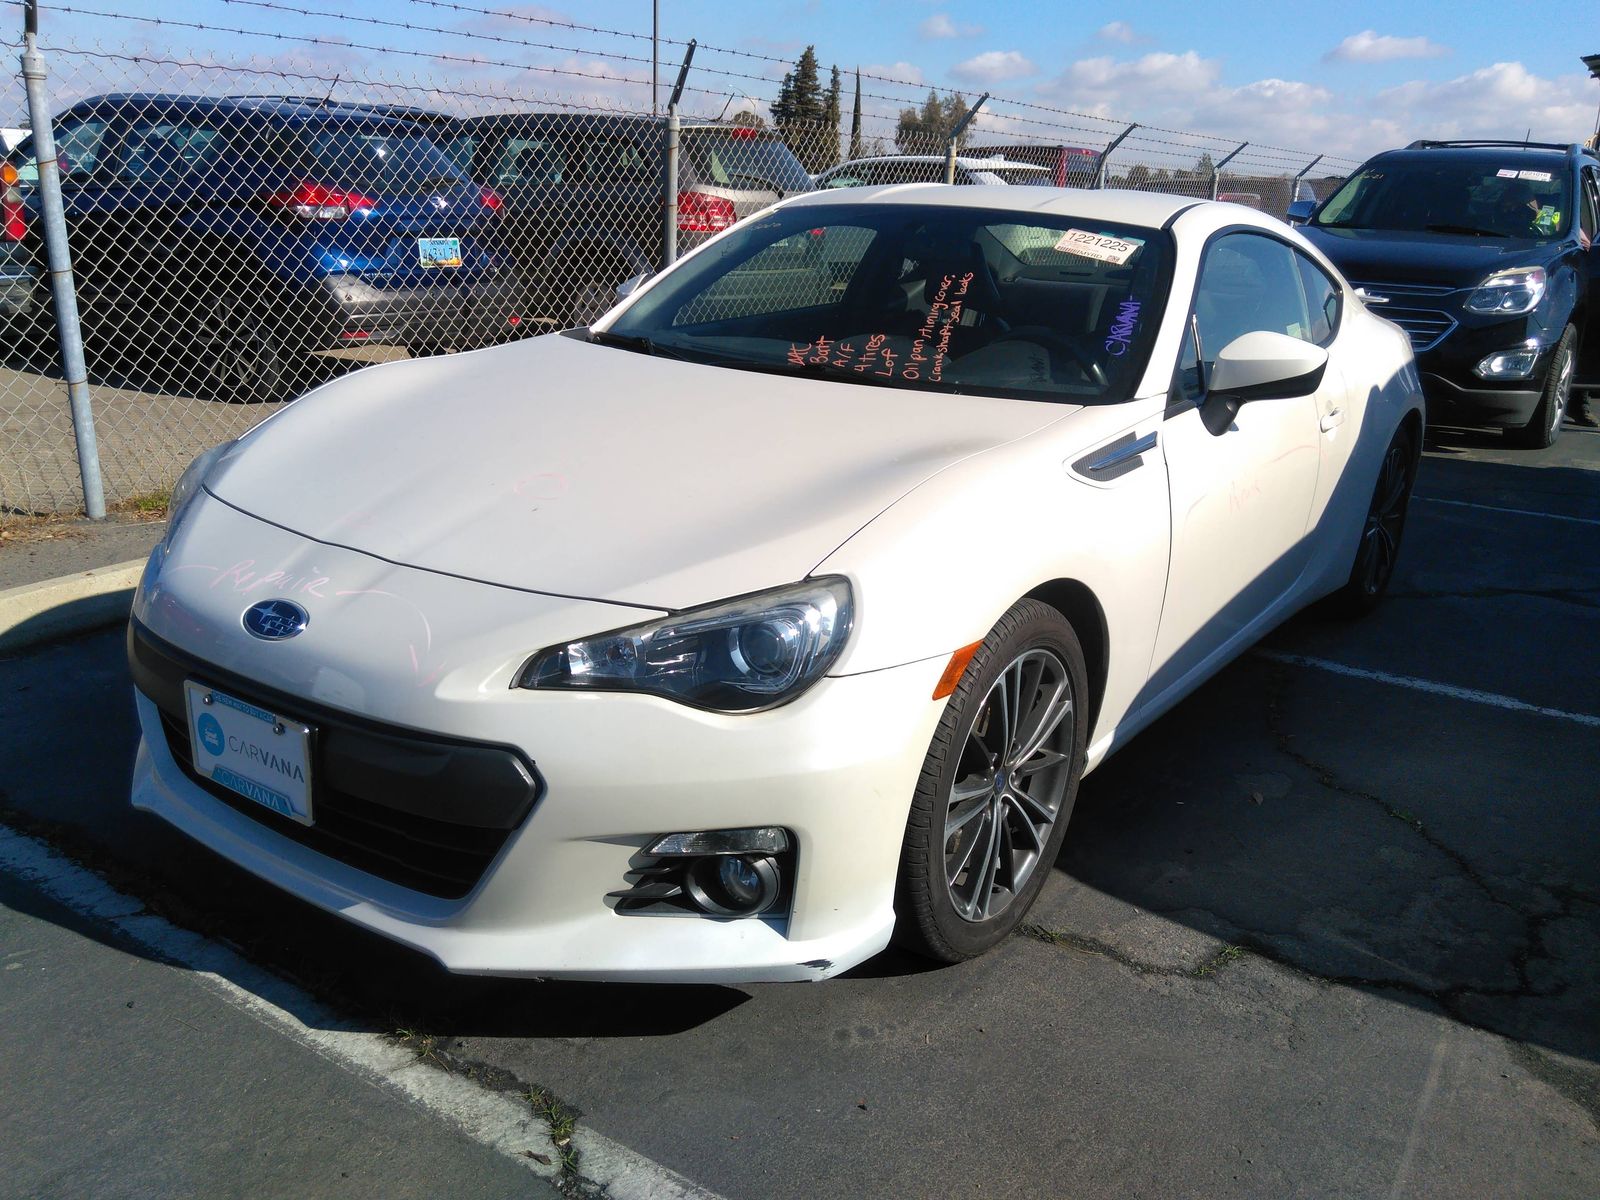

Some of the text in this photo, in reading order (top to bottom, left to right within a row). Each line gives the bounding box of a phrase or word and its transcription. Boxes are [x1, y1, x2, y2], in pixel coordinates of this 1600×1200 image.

[1068, 232, 1128, 252] 1221225
[910, 339, 927, 361] pan
[228, 735, 305, 783] CARVANA
[220, 770, 280, 810] CARVANA
